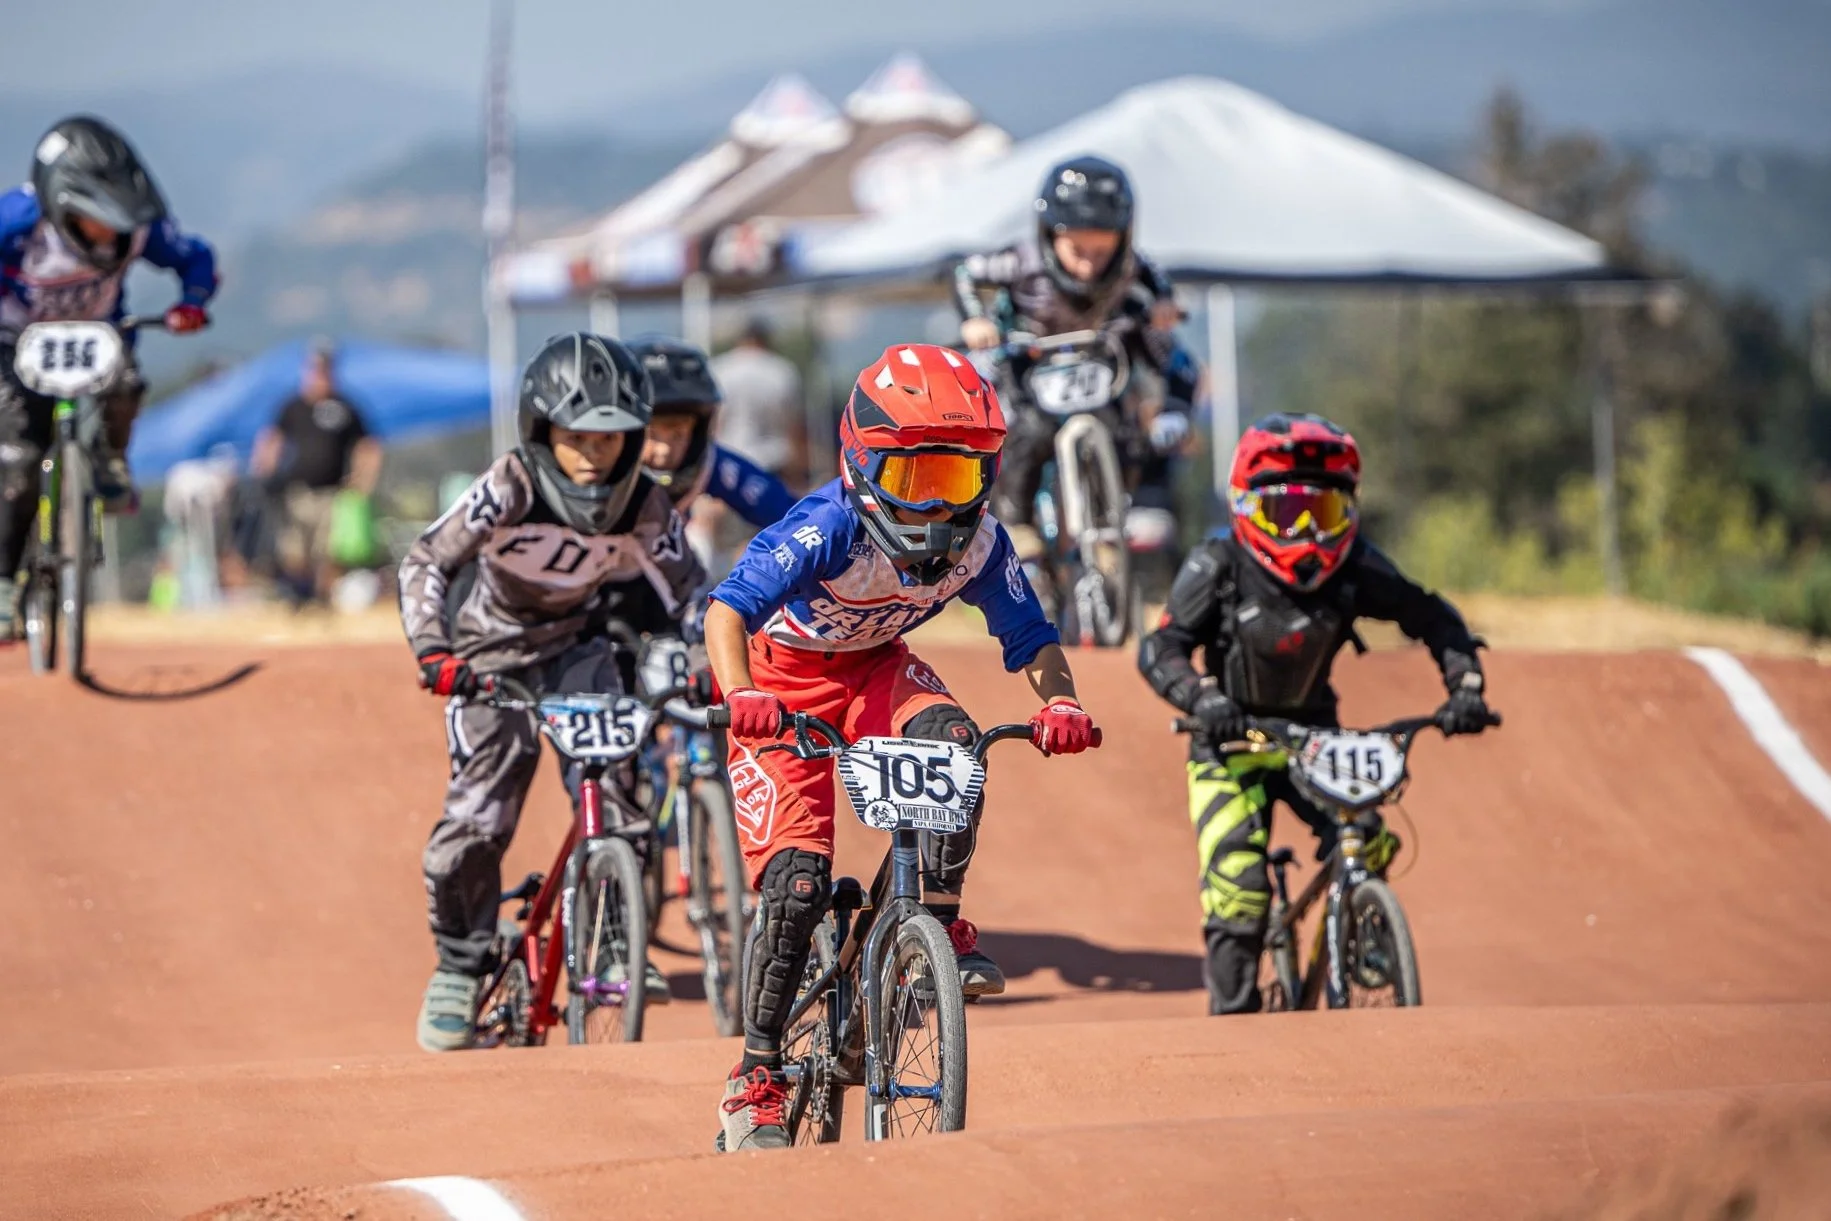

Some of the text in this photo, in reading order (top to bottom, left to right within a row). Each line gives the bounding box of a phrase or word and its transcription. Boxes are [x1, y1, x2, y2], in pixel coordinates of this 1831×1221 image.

[569, 700, 636, 747] 215
[873, 752, 955, 803] 105
[1325, 746, 1382, 783] 115
[901, 806, 930, 820] NORTH
[931, 808, 948, 822] BAY
